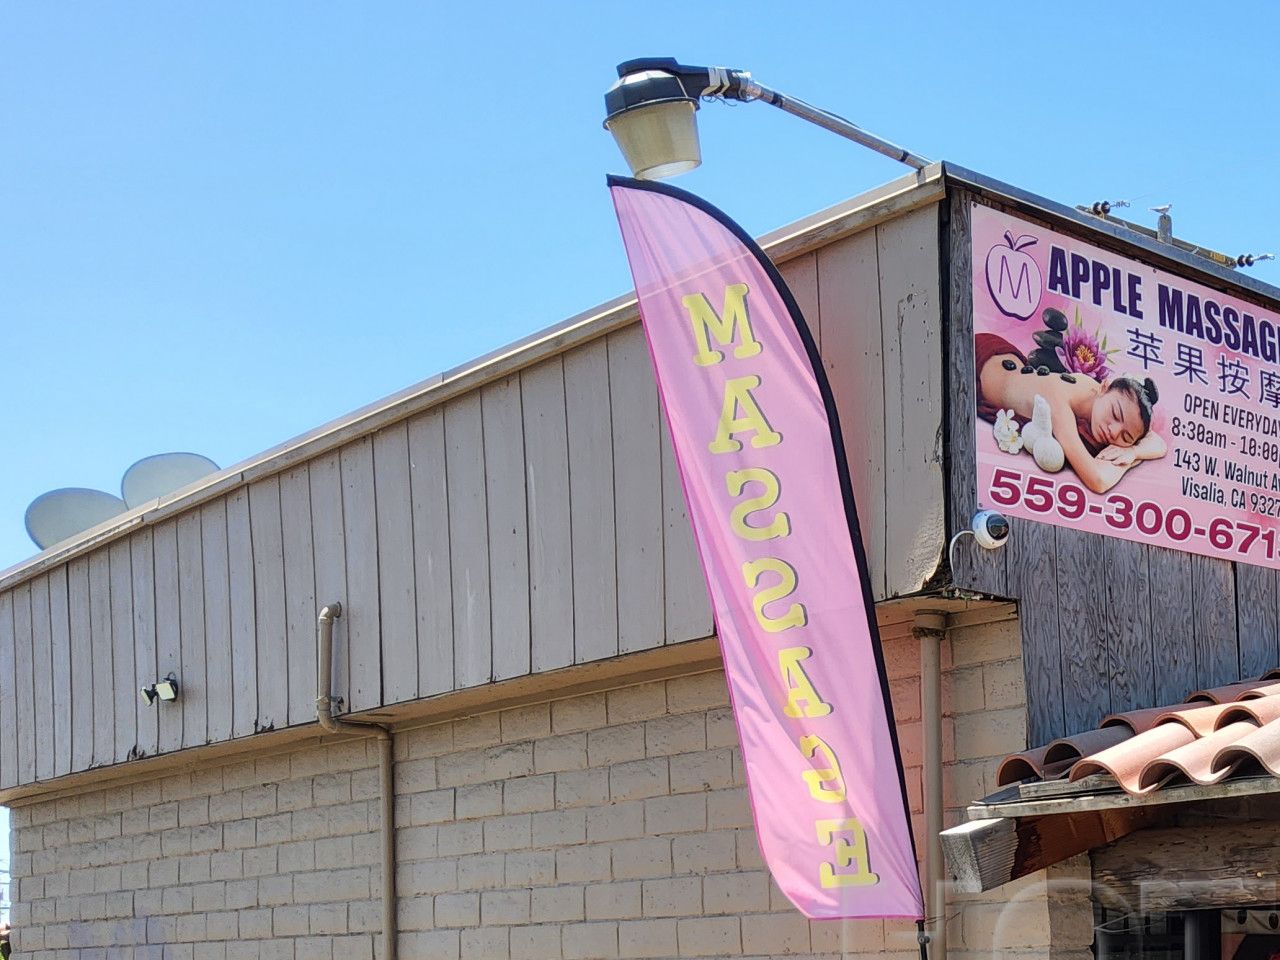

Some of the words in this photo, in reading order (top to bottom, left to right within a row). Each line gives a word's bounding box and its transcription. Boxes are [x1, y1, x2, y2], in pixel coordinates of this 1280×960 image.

[1048, 246, 1144, 320] APPLE
[1184, 393, 1220, 421] OPEN
[1171, 416, 1227, 449] 8:30am
[1173, 448, 1201, 472] 143
[1204, 455, 1220, 477] W.
[1224, 460, 1268, 489] Walnut
[1182, 476, 1227, 507] Visalia,
[1231, 488, 1246, 509] CA
